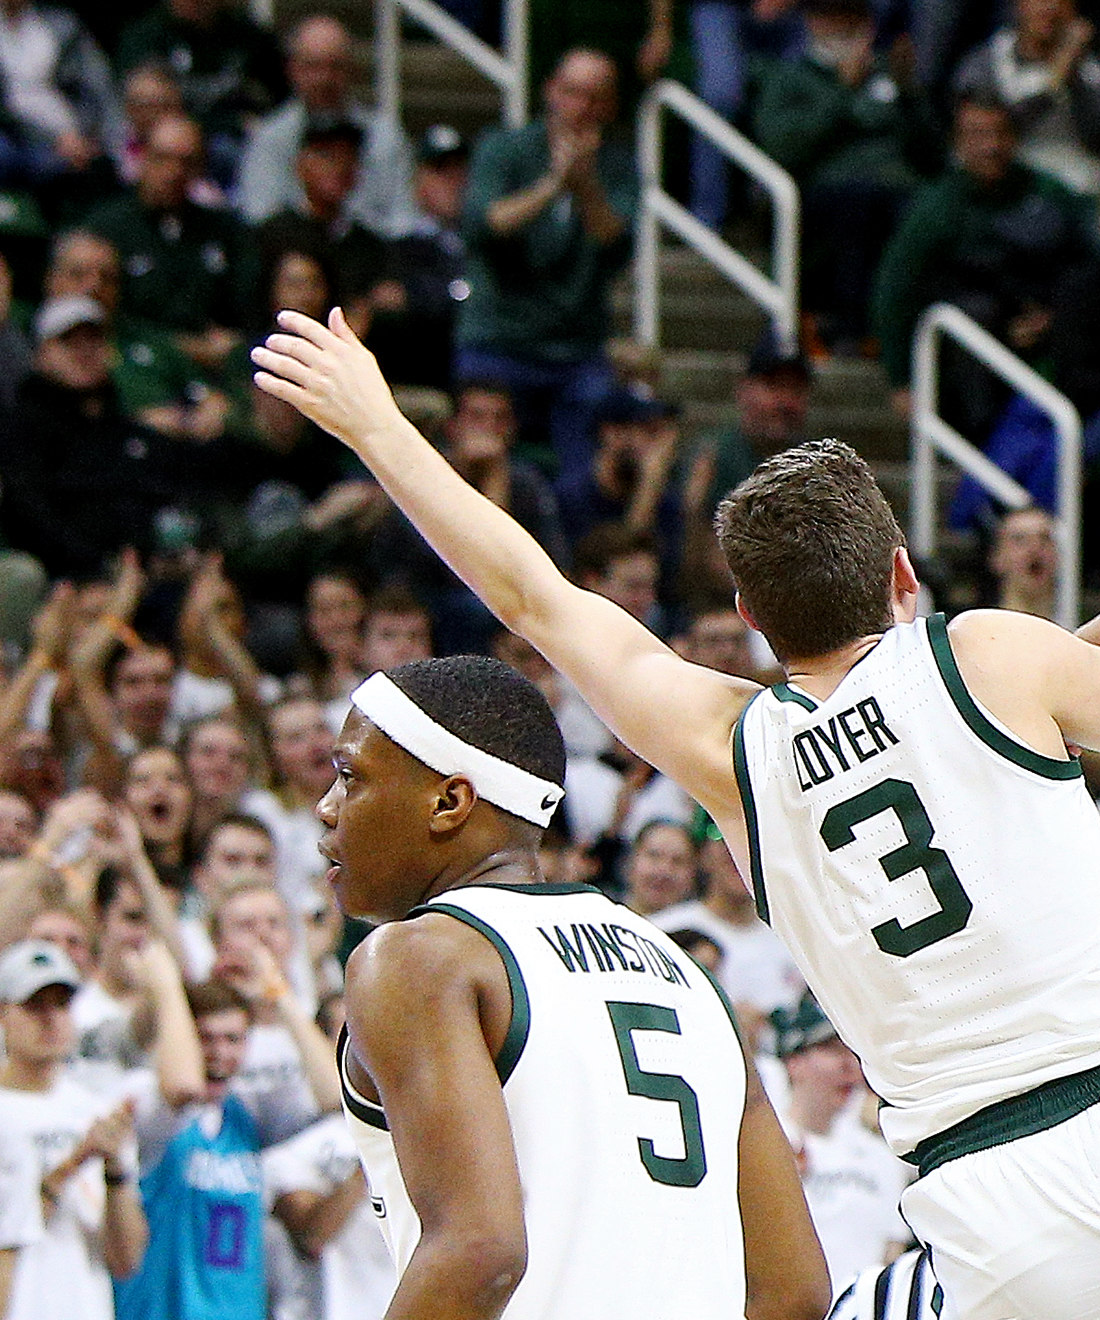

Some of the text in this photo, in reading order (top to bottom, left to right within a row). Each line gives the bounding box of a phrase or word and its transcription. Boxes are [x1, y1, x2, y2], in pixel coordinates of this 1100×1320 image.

[792, 696, 900, 792] LOYER
[820, 778, 973, 958] 3
[536, 923, 692, 989] WINSTON
[604, 1001, 707, 1187] 5
